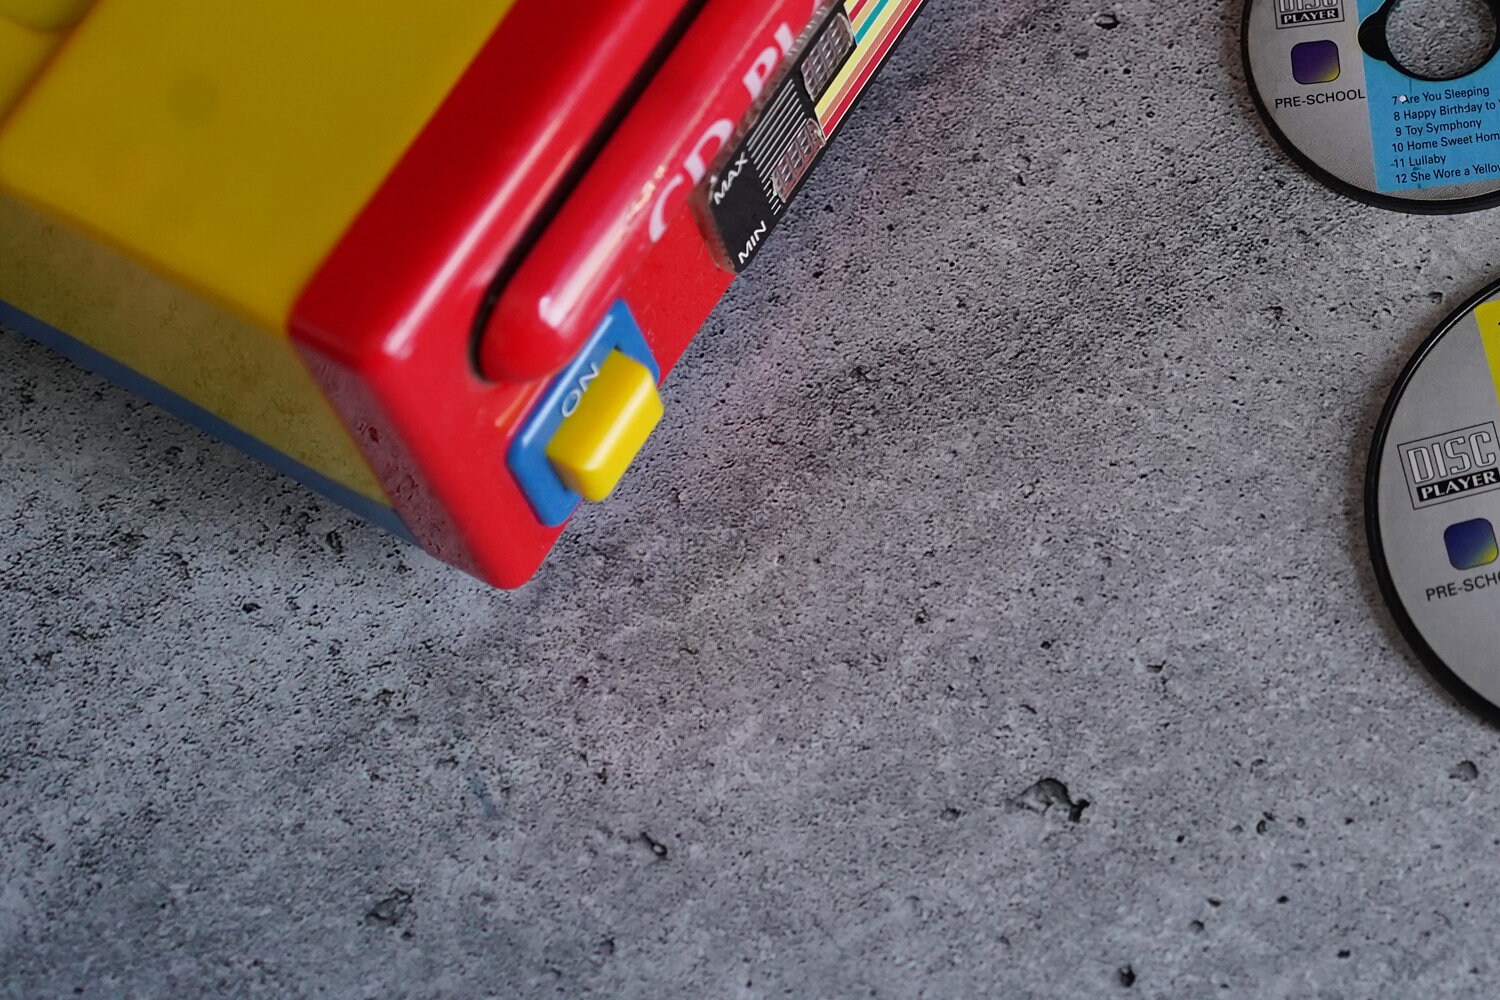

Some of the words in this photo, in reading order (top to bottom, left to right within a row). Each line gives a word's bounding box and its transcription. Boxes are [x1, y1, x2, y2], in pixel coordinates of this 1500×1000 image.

[1283, 10, 1337, 24] PLAYER
[1275, 89, 1366, 109] PRE-SCHOOL
[1393, 111, 1401, 122] 8
[1403, 109, 1437, 120] Happy
[1439, 103, 1483, 116] Birthday
[1485, 101, 1496, 111] to
[1395, 126, 1402, 137] 9
[1404, 125, 1424, 136] Toy
[1425, 119, 1482, 134] Symphony
[1391, 142, 1404, 153] 10
[1406, 140, 1438, 151] Home
[1440, 135, 1473, 147] Sweet
[1393, 157, 1405, 169] 11
[1408, 153, 1447, 168] Lullaby
[714, 151, 748, 205] MAX
[738, 220, 767, 265] MIN
[561, 362, 599, 418] ON
[1407, 431, 1497, 484] DISC
[1420, 471, 1498, 501] PLAYER
